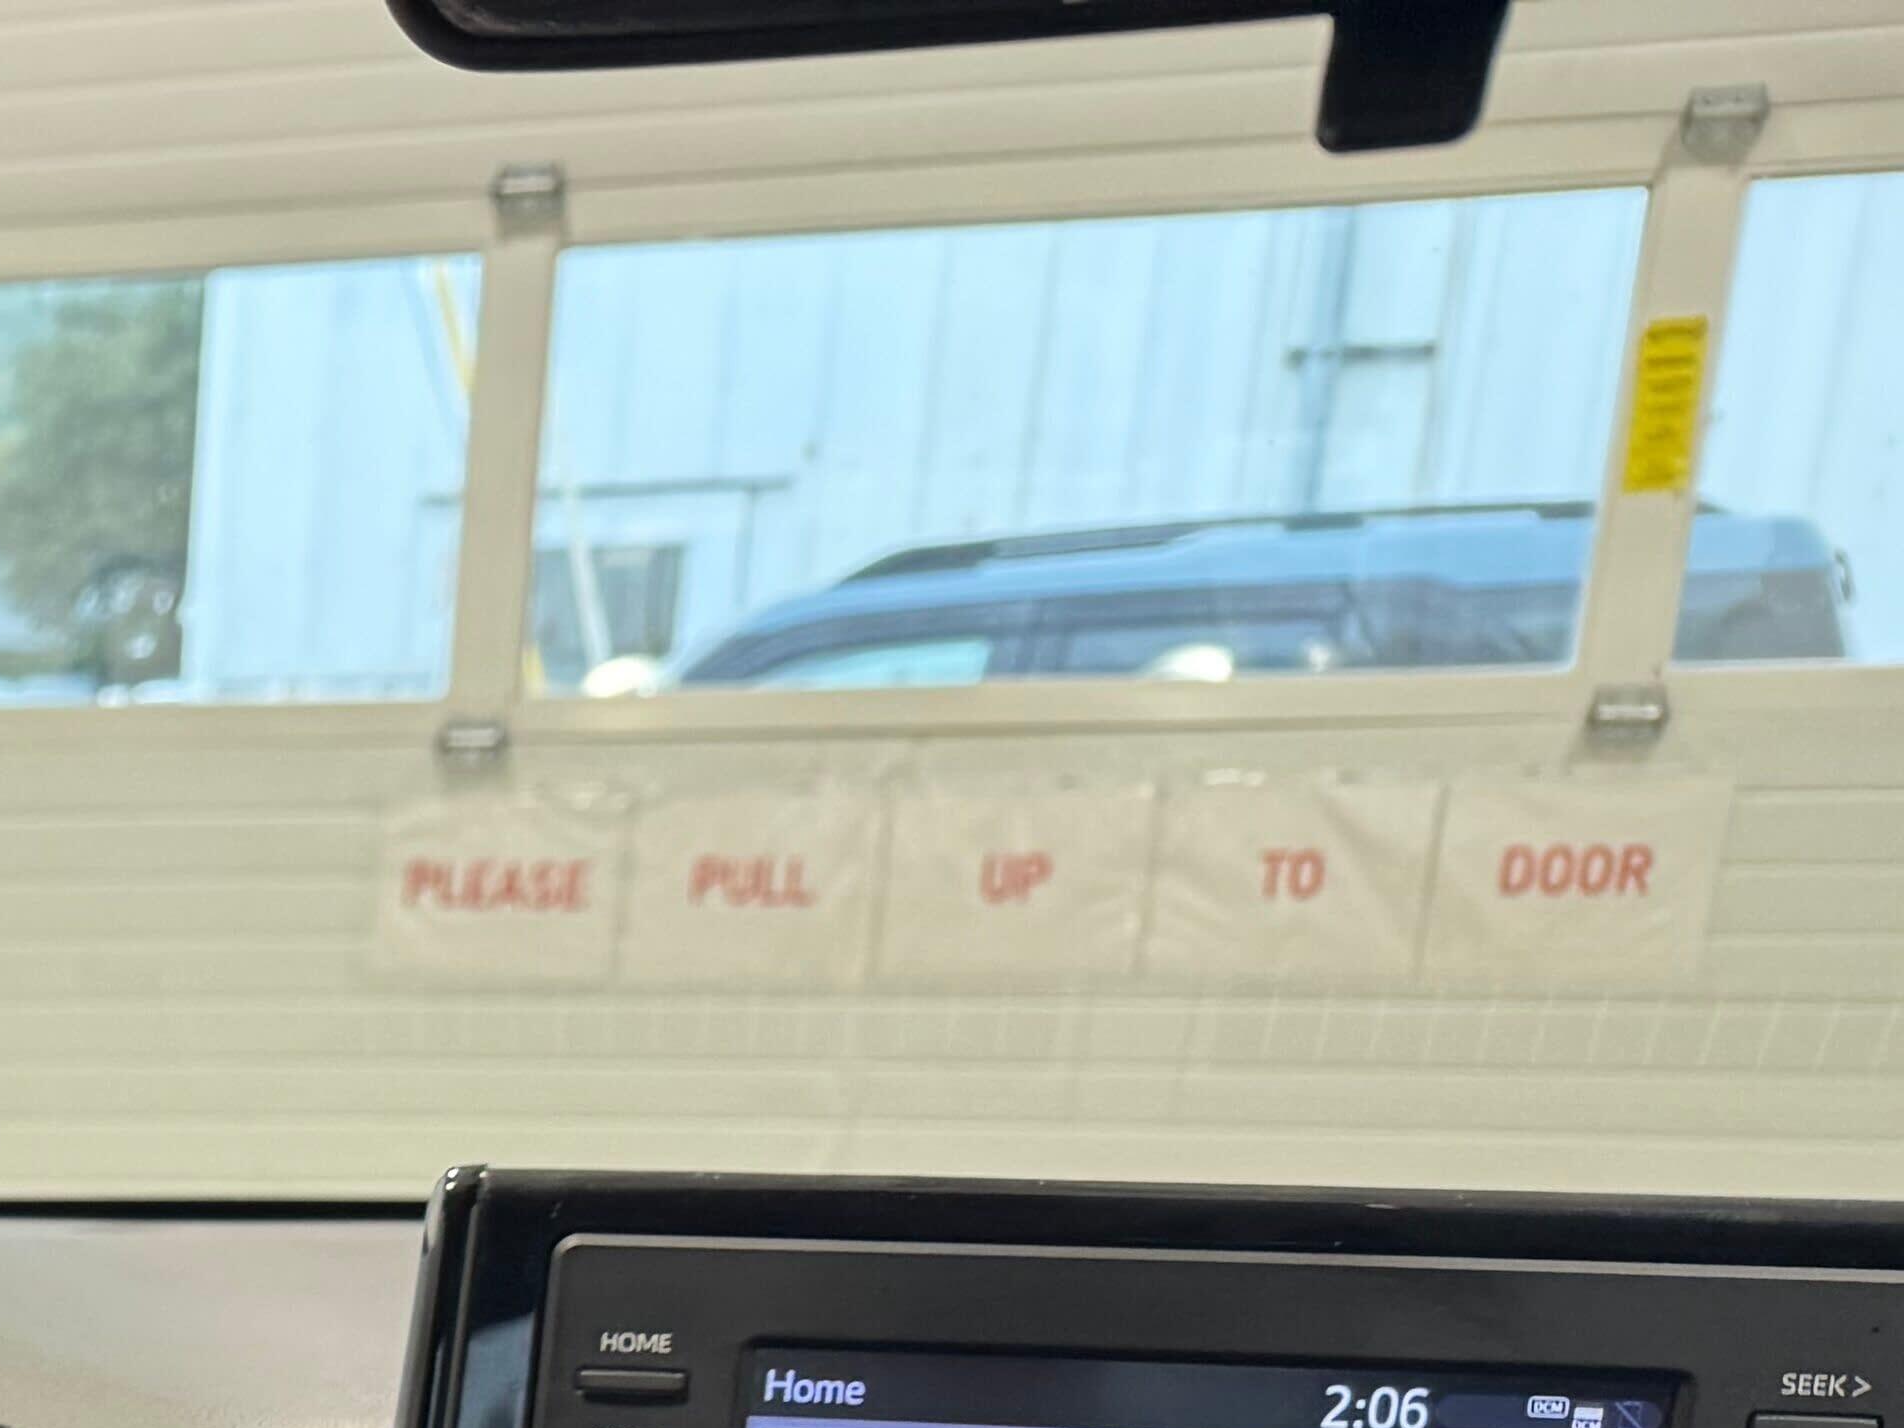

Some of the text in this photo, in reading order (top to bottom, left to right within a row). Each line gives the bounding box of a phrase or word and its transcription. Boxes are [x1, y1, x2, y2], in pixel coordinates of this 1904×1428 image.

[402, 843, 1655, 912] PLEASE PULL UP TO DOOR
[600, 1331, 673, 1354] HOME
[764, 1368, 867, 1406] Home
[1781, 1373, 1847, 1398] SEEK
